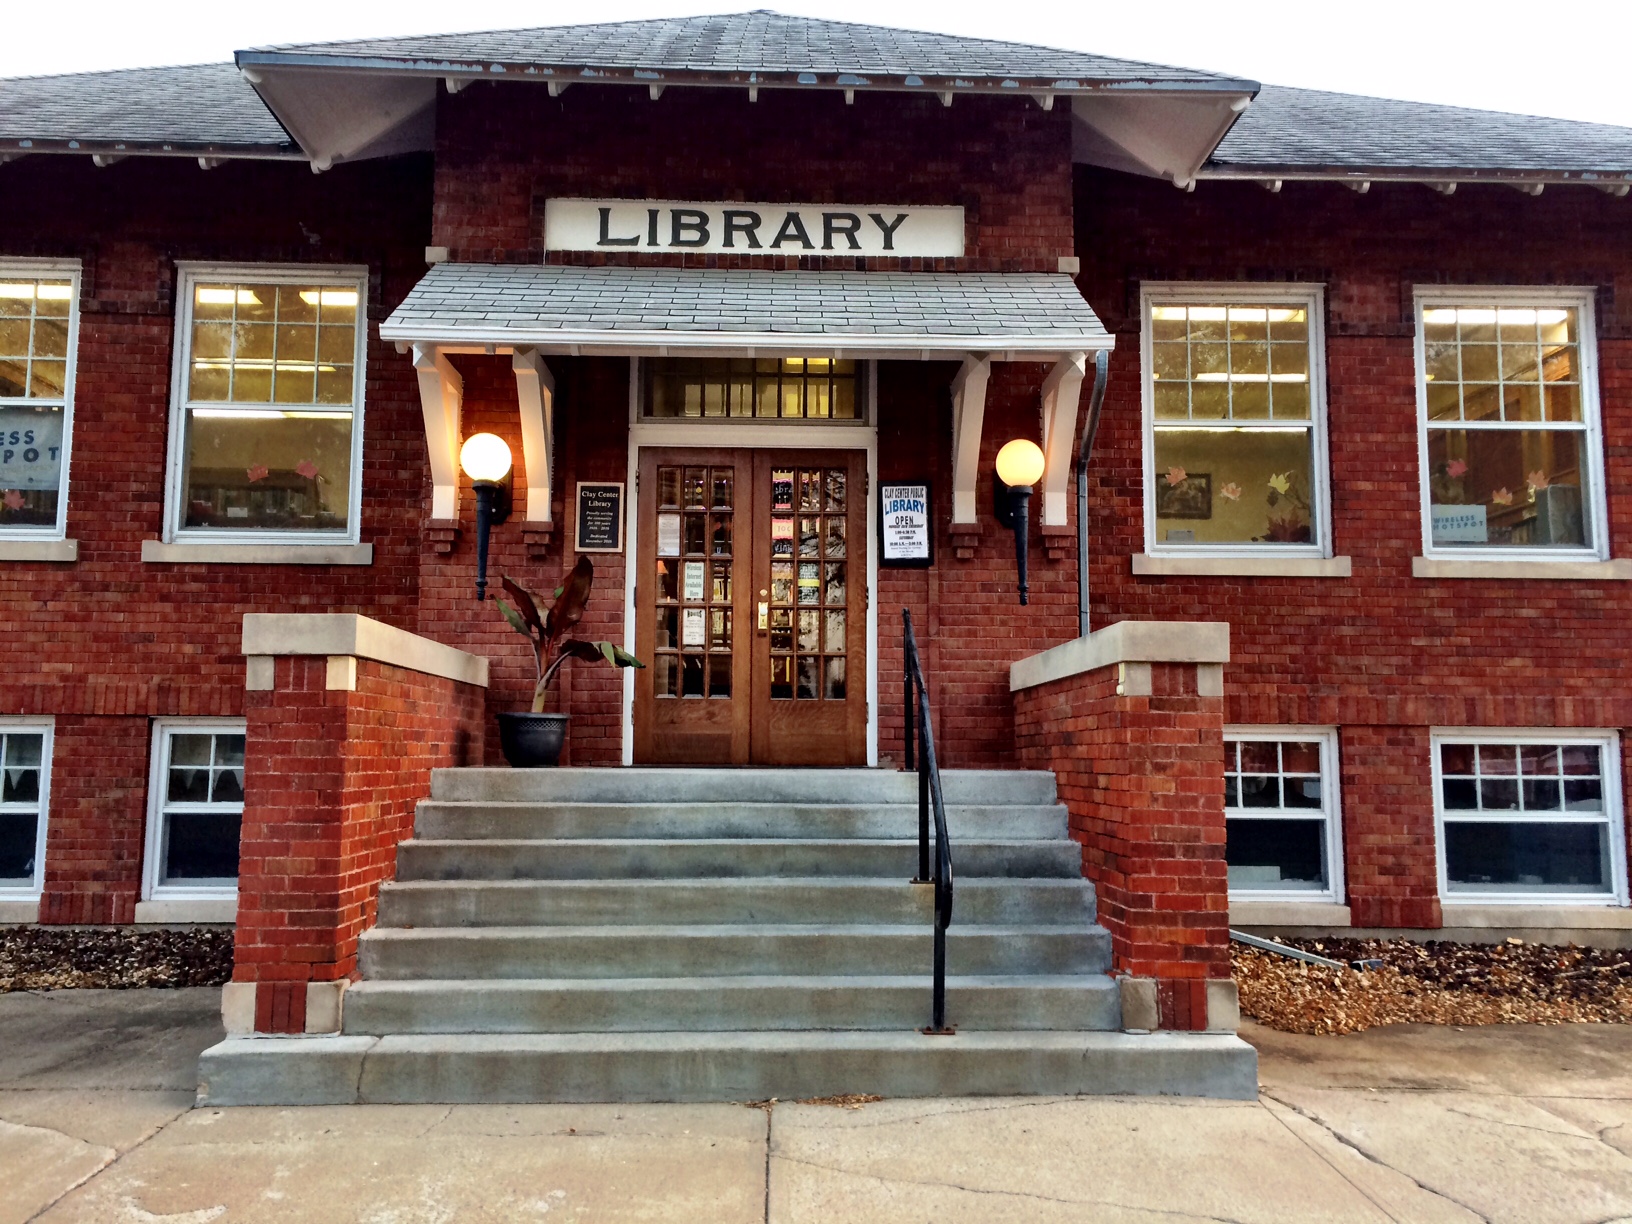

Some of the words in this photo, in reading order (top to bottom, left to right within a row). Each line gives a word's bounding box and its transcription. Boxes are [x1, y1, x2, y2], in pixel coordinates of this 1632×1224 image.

[597, 207, 909, 251] LIBRARY
[885, 488, 894, 498] CLAY
[895, 488, 909, 498] CENTER
[911, 488, 924, 498] PUBLIC
[885, 499, 924, 515] LIBRARY
[895, 516, 913, 525] OPEN
[1433, 515, 1475, 523] WIRELESS
[1432, 520, 1483, 530] HOTSPOT
